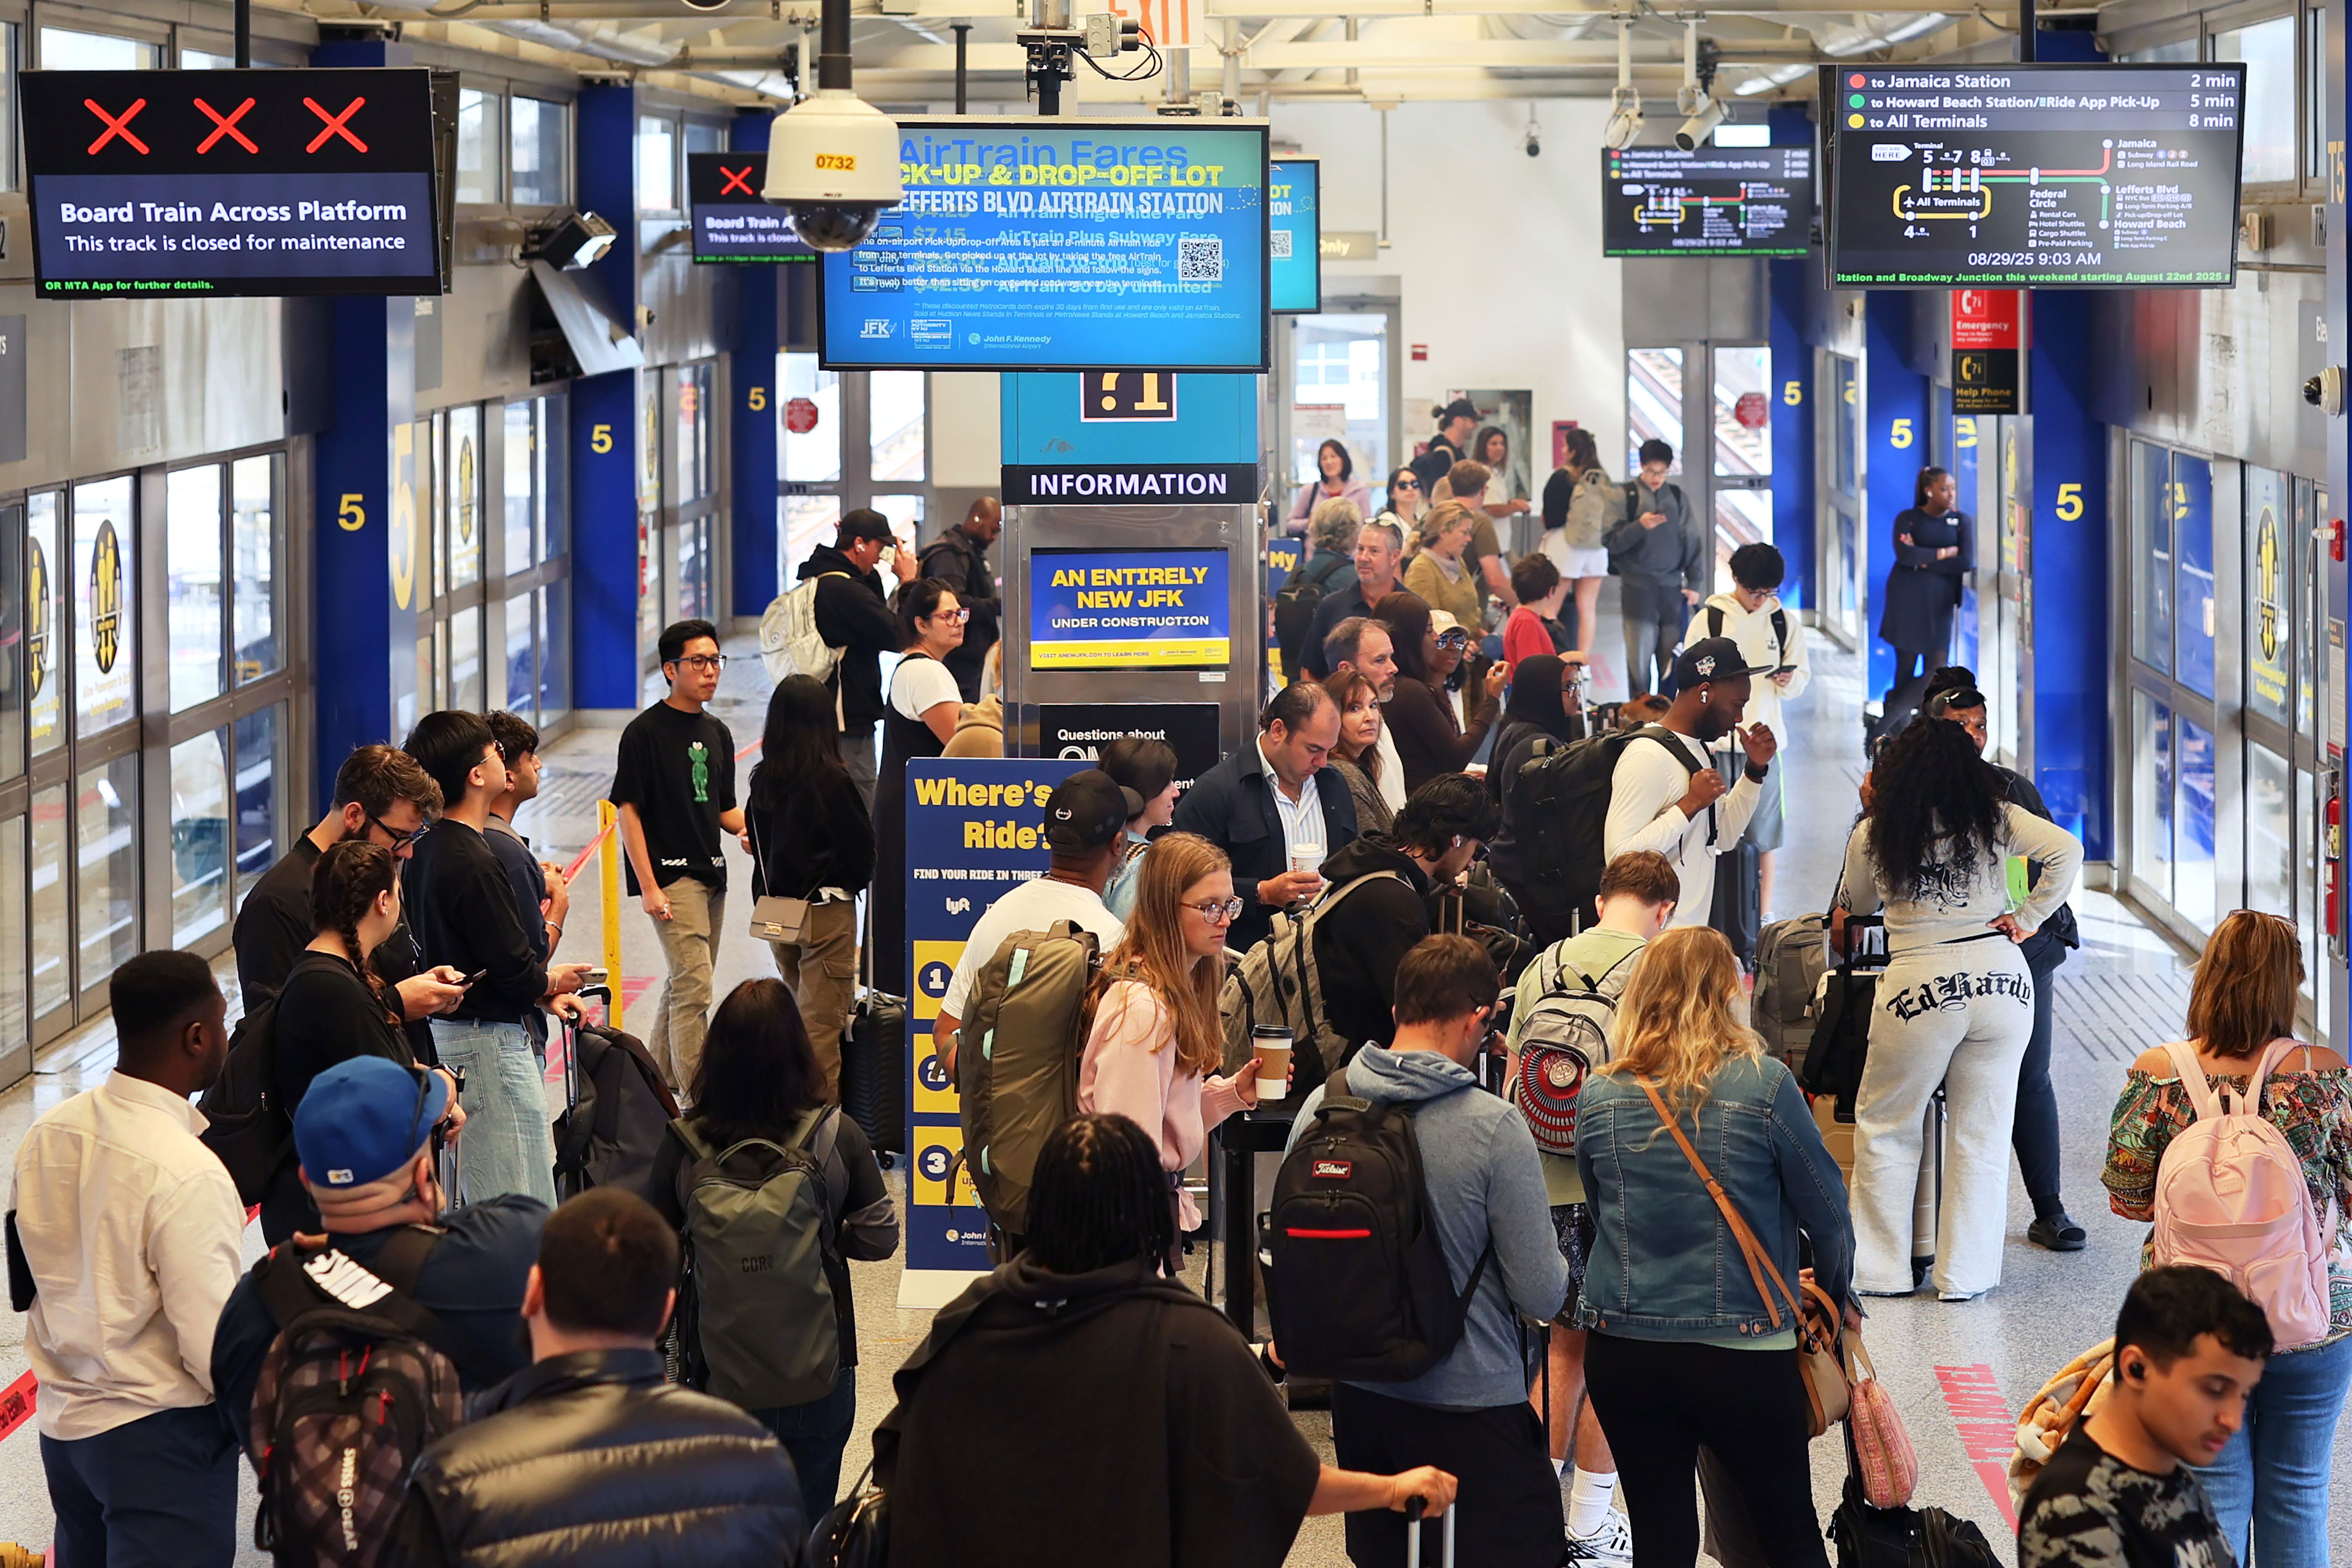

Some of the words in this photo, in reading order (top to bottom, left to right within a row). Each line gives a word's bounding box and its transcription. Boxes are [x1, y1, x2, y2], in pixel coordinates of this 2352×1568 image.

[1871, 78, 1885, 88] to
[1887, 74, 1950, 89] Jamaica
[1955, 74, 2011, 88] Station
[2190, 74, 2200, 87] 2
[2205, 74, 2236, 87] min
[1871, 99, 1883, 108] to
[1886, 96, 1939, 108] Howard
[1943, 97, 1982, 108] Beach
[2079, 97, 2107, 110] App
[2110, 96, 2160, 110] Pick-Up
[2190, 95, 2200, 108] 5
[2205, 94, 2235, 107] min
[1870, 119, 1884, 128] to
[1887, 114, 1909, 128] All
[1912, 114, 1987, 128] Terminals
[2189, 114, 2199, 127] 8
[2204, 114, 2233, 127] min
[2117, 139, 2157, 149] Jamaica
[900, 135, 1056, 168] AirTrain
[1071, 140, 1188, 169] Fares
[1923, 151, 1933, 163] 5
[1953, 150, 1963, 163] 7
[1970, 150, 1981, 163] 8
[816, 155, 854, 170] 0732
[900, 163, 980, 185] CK-UP
[988, 164, 1013, 185] &
[1019, 164, 1162, 186] DROP-OFF
[1170, 165, 1224, 187] LOT
[2030, 189, 2067, 199] Federal
[2115, 185, 2153, 194] Lefferts
[2157, 185, 2179, 193] Blvd
[984, 191, 1035, 212] BLVD
[1038, 191, 1134, 213] AIRTRAIN
[1139, 192, 1224, 214] STATION
[1916, 197, 1930, 206] All
[1933, 197, 1981, 206] Terminals
[2029, 199, 2057, 208] Circle
[60, 201, 134, 223] Board
[140, 201, 202, 222] Train
[210, 202, 291, 222] Across
[298, 200, 407, 221] Platform
[705, 216, 745, 229] Board
[746, 216, 780, 229] Train
[2114, 220, 2154, 228] Howard
[2157, 220, 2186, 228] Beach
[707, 232, 729, 243] This
[730, 232, 755, 243] track
[1904, 225, 1915, 238] 4
[1969, 225, 1977, 238] 1
[64, 235, 104, 252] This
[108, 235, 156, 251] track
[162, 235, 177, 251] is
[181, 234, 241, 251] closed
[246, 234, 276, 251] for
[281, 234, 405, 250] maintenance
[877, 238, 923, 247] on-airport
[924, 238, 999, 247] Pick-Up/Drop-Off
[1065, 238, 1106, 247] 8-minute
[1968, 253, 2034, 266] 08/29/25
[2038, 253, 2071, 265] 9:03
[2076, 253, 2101, 265] AM
[975, 265, 989, 273] the
[991, 265, 1024, 273] Howard
[1092, 266, 1118, 274] follow
[1120, 266, 1134, 274] the
[1137, 267, 1161, 276] signs.
[1837, 273, 1873, 282] Station
[1898, 273, 1953, 283] Broadway
[2005, 273, 2025, 281] this
[2081, 273, 2122, 283] starting
[2126, 272, 2164, 282] August
[2196, 272, 2222, 281] 2025
[45, 281, 62, 290] OR
[64, 281, 89, 290] MTA
[92, 281, 114, 291] App
[116, 281, 130, 290] for
[134, 280, 171, 290] further
[173, 280, 214, 290] details.
[1956, 321, 2009, 331] Emergency
[1014, 336, 1052, 344] Kennedy
[748, 387, 766, 411] 5
[1783, 381, 1802, 405] 5
[1956, 388, 1978, 397] Help
[1981, 388, 2011, 396] Phone
[591, 424, 613, 454] 5
[1890, 418, 1914, 449] 5
[1030, 473, 1227, 495] INFORMATION
[2056, 483, 2084, 521] 5
[338, 494, 366, 531] 5
[393, 422, 415, 611] 5
[1269, 550, 1297, 573] My
[1051, 569, 1085, 587] AN
[1091, 567, 1208, 586] ENTIRELY
[1077, 591, 1134, 609] NEW
[1137, 589, 1184, 608] JFK
[1051, 617, 1098, 629] UNDER
[1101, 616, 1209, 628] CONSTRUCTION
[1057, 729, 1123, 741] Questions
[1127, 729, 1165, 740] about
[914, 869, 939, 880] FIND
[941, 870, 967, 880] YOUR
[969, 870, 994, 880] RIDE
[996, 870, 1009, 881] IN
[928, 969, 944, 989] 1
[927, 1061, 946, 1082] 2
[927, 1152, 947, 1174] 3
[1315, 1163, 1348, 1175] Titleist
[303, 1248, 394, 1310] NIKE
[1934, 1363, 2012, 1419] HOTEL
[341, 1447, 357, 1489] SWISS
[341, 1508, 358, 1552] GEAR
